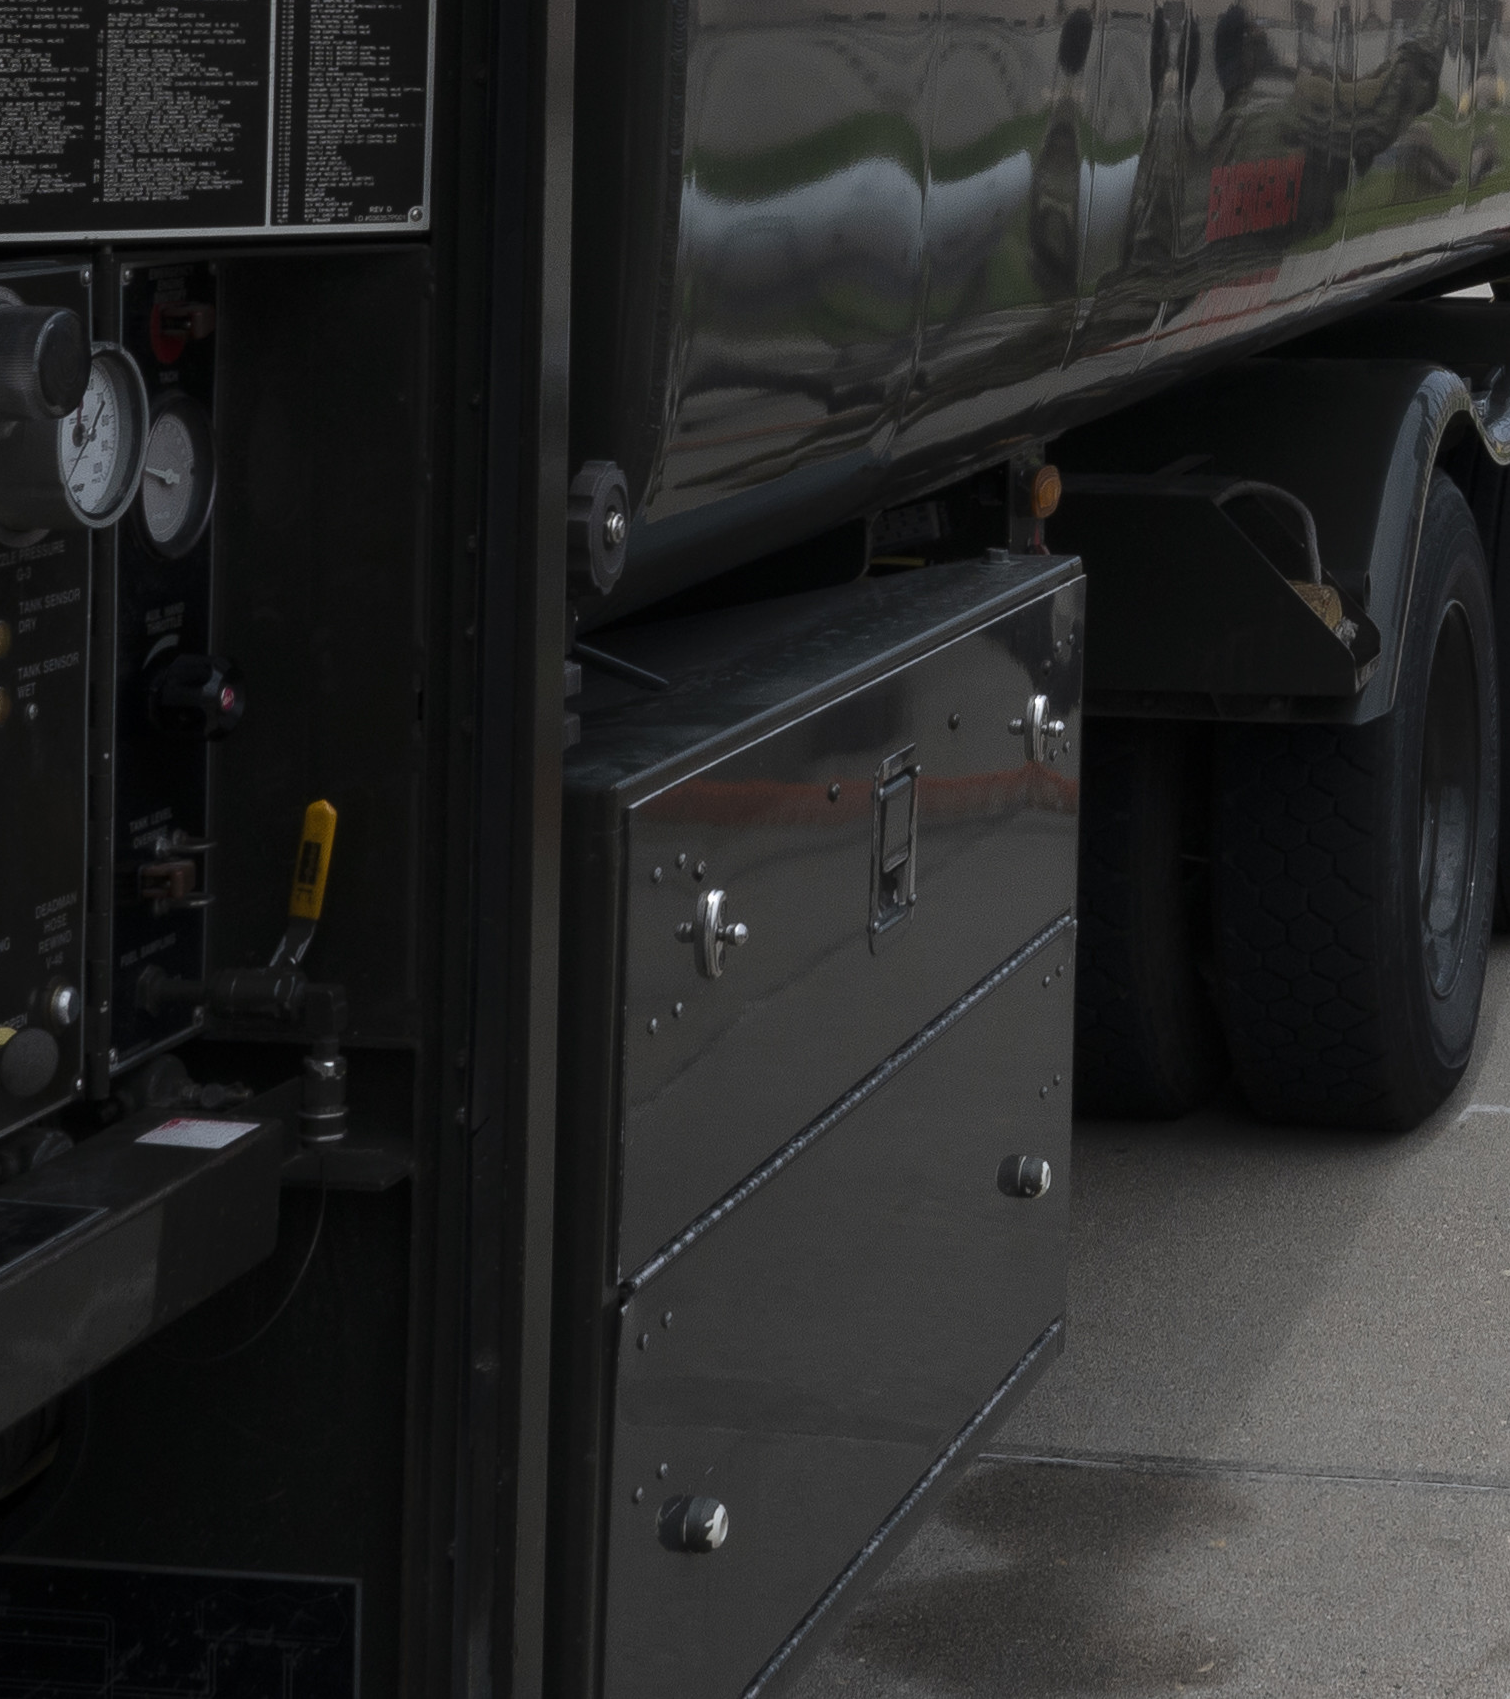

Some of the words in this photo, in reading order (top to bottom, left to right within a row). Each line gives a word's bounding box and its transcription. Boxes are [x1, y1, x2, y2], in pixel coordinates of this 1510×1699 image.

[19, 539, 66, 562] PRESSURE
[19, 597, 43, 616] TANK
[44, 588, 82, 610] SENSOR
[18, 616, 38, 634] DRY
[17, 663, 42, 682] TANK
[42, 651, 80, 676] SENSOR
[17, 682, 37, 699] WET
[35, 891, 78, 920] DEADMAN
[43, 914, 67, 934] HOSE
[38, 930, 73, 955] REWIND
